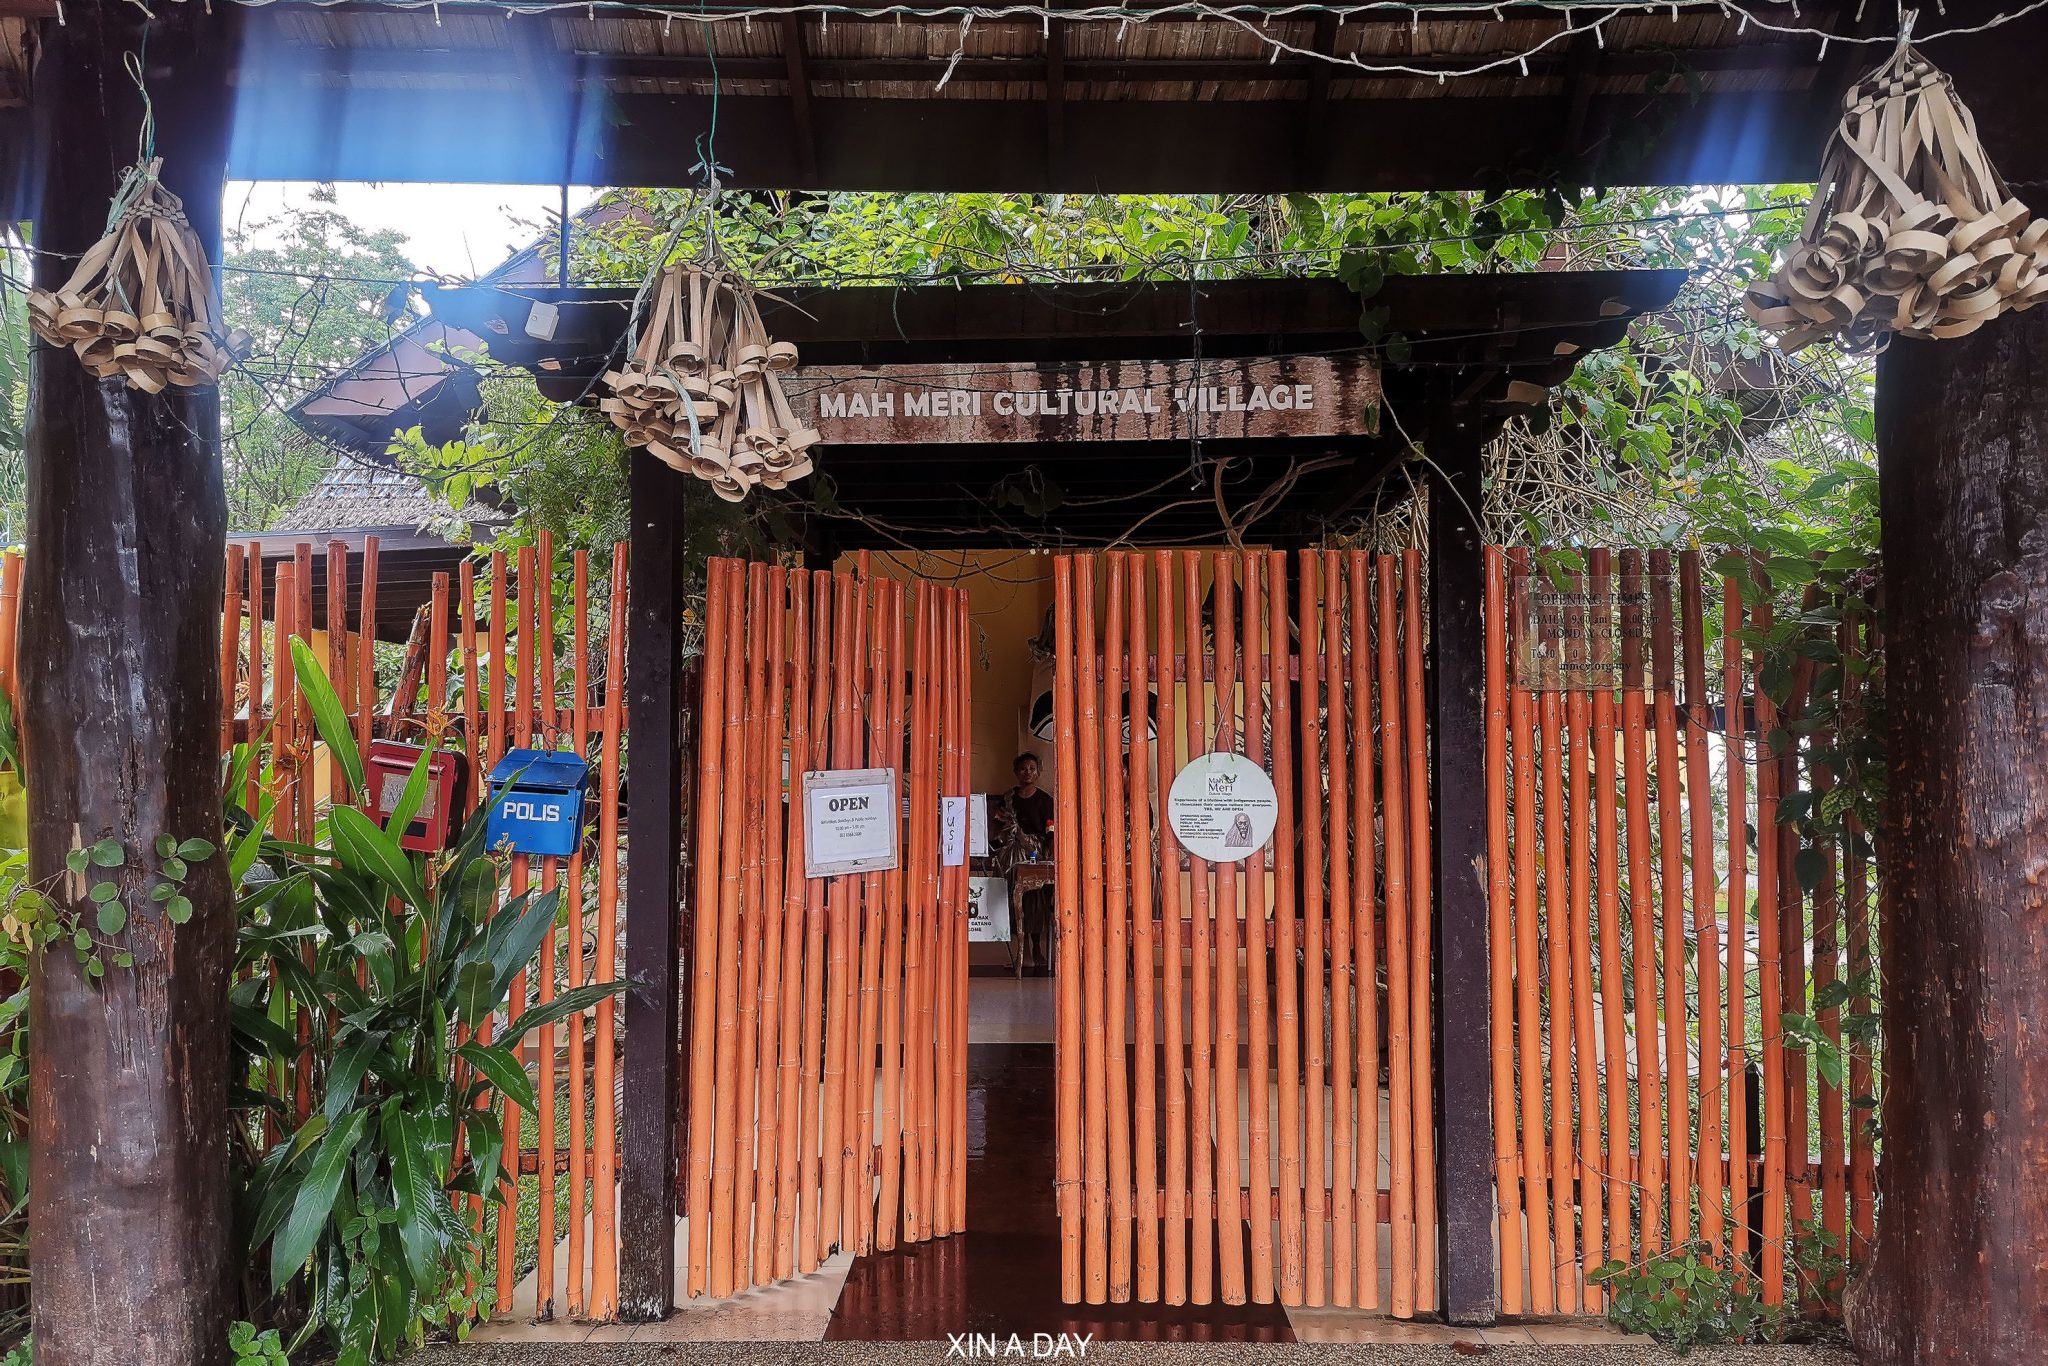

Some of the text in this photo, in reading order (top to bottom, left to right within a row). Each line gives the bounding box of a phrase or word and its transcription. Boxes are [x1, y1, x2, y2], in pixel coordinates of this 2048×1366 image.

[820, 384, 1314, 419] MAH MERI CULTURAL VILLAGE
[1541, 592, 1649, 605] OPENING TIMES
[1533, 614, 1565, 625] DAILY
[1601, 628, 1643, 638] CLOSED
[1208, 783, 1233, 792] Meri
[828, 796, 870, 812] OPEN
[502, 801, 560, 822] POLIS
[946, 800, 955, 855] PUSH
